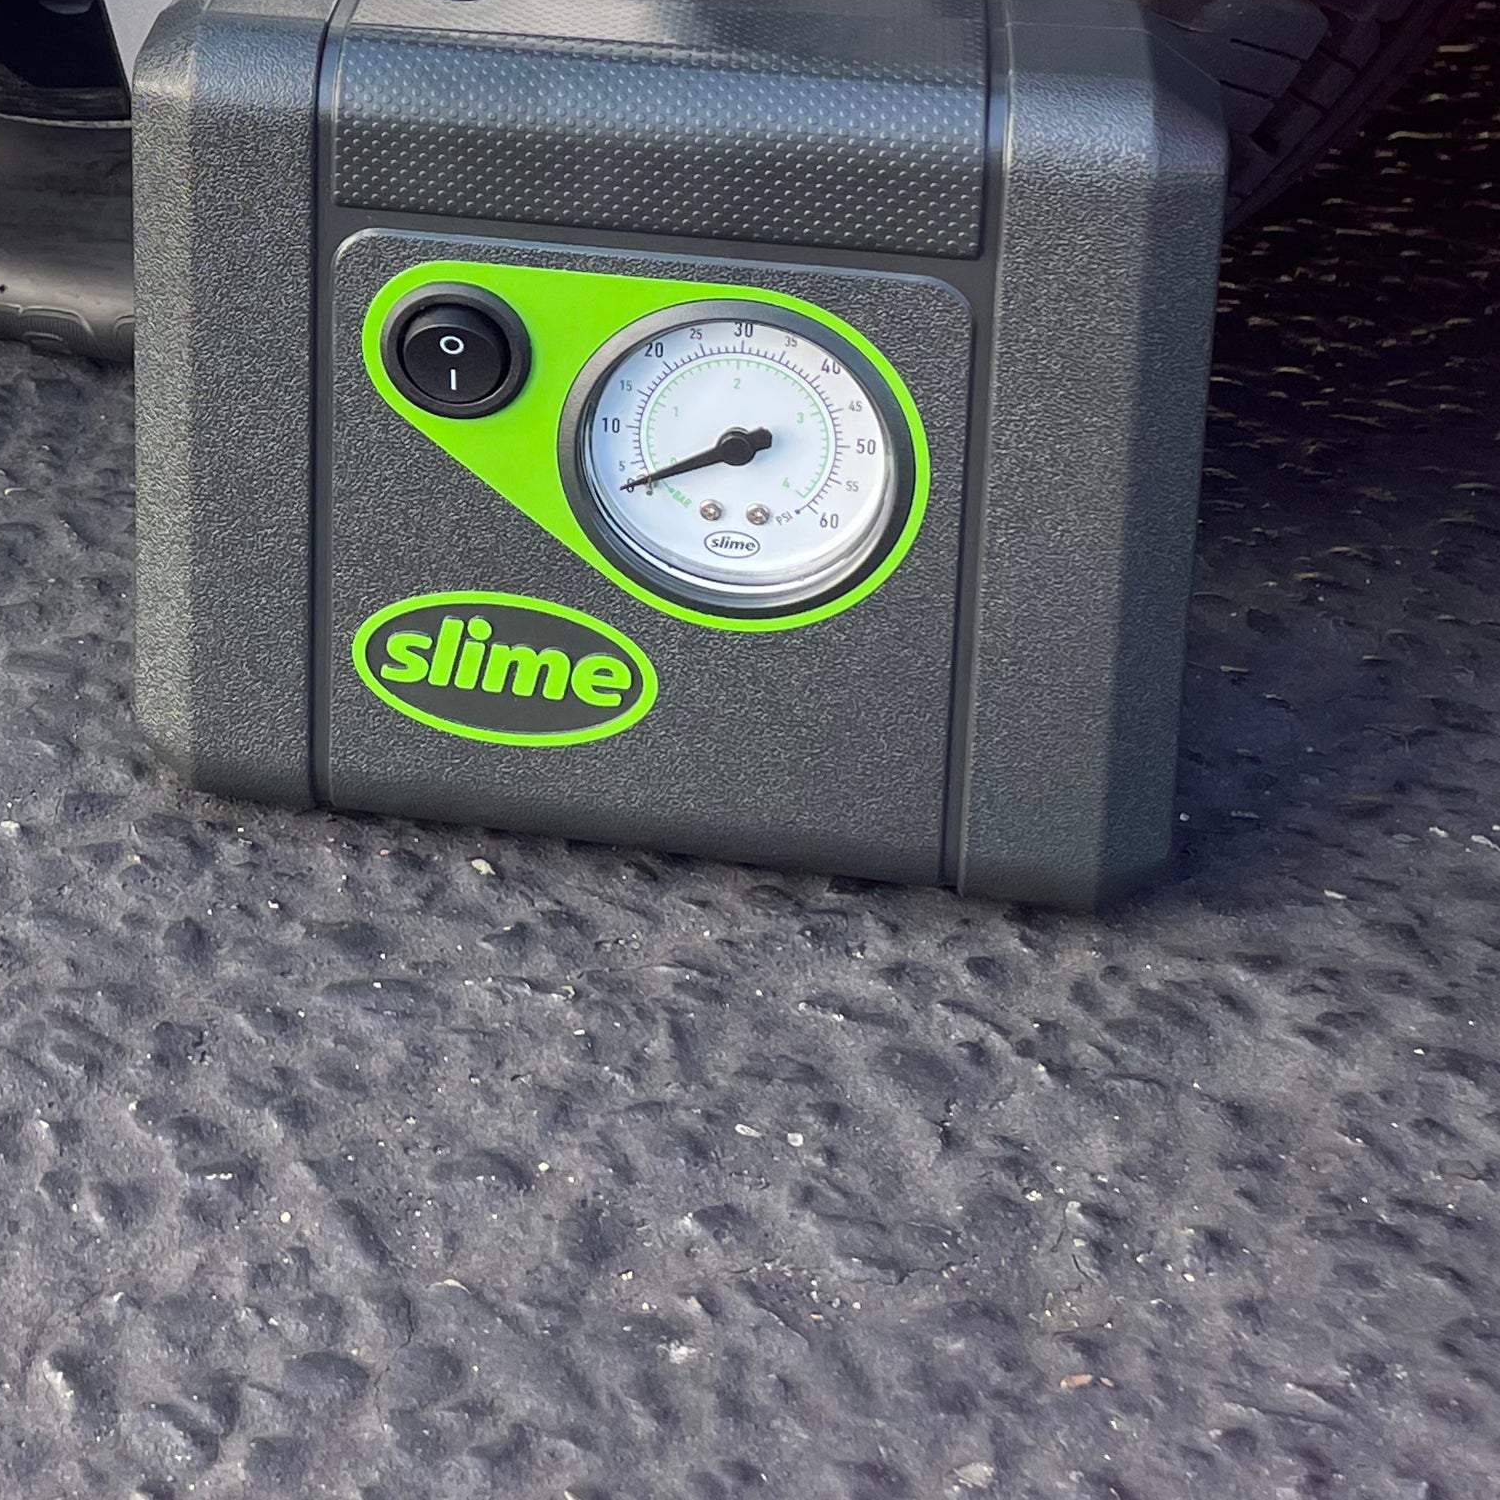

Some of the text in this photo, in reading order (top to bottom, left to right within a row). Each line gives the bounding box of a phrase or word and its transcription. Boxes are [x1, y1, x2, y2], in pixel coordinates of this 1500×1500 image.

[689, 328, 703, 340] 25
[734, 322, 754, 338] 30
[644, 342, 664, 358] 20
[785, 335, 798, 349] 35
[821, 358, 841, 375] 40
[619, 380, 633, 393] 15
[733, 378, 741, 390] 2
[849, 401, 863, 413] 45
[602, 417, 620, 434] 10
[796, 412, 804, 424] 3
[856, 438, 876, 455] 50
[618, 461, 626, 472] 5
[782, 477, 790, 489] 4
[845, 480, 859, 492] 55
[672, 488, 693, 509] BAR
[776, 510, 793, 527] PSI
[819, 513, 839, 529] 60
[711, 536, 756, 552] slime
[380, 615, 632, 707] slime
